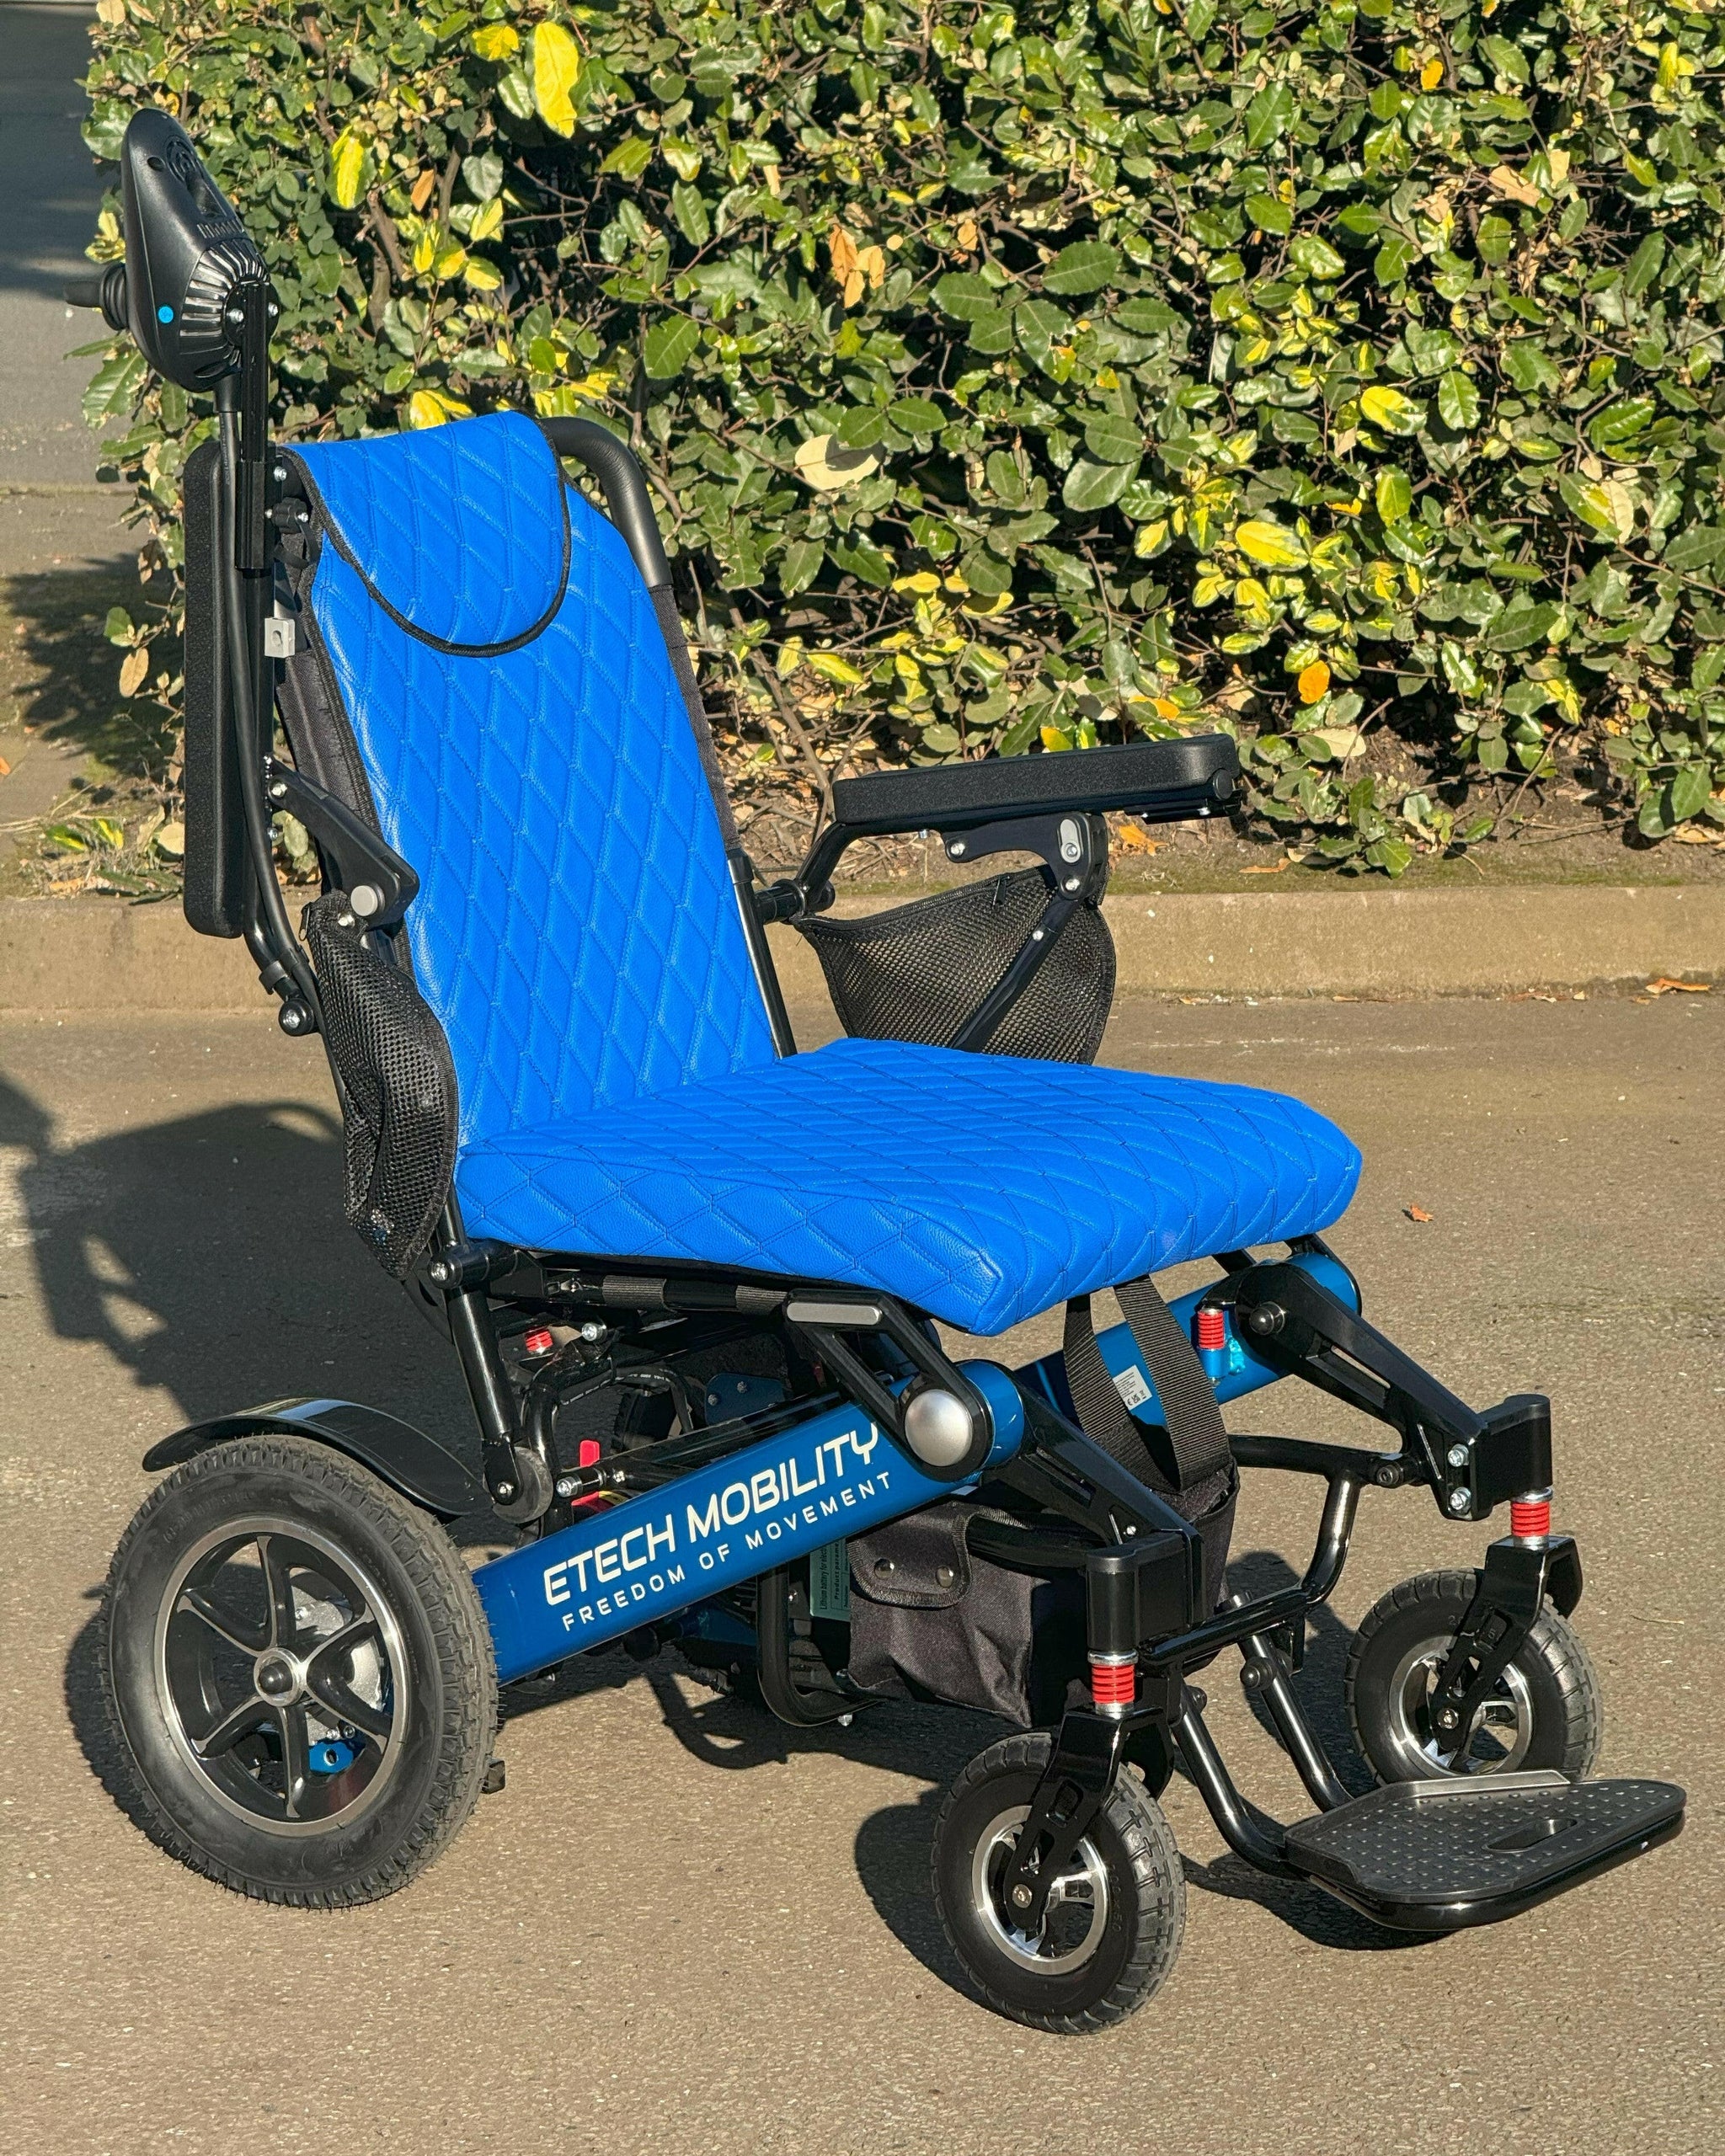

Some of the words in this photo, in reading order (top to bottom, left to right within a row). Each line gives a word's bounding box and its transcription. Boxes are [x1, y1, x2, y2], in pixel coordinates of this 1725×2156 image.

[543, 1513, 676, 1606] ETECH
[686, 1422, 879, 1544] MOBILITY
[562, 1565, 686, 1632] FREEDOM
[699, 1544, 730, 1570] OF
[745, 1471, 889, 1550] MOVEMENT
[820, 1562, 828, 1571] for
[820, 1571, 829, 1589] battery
[820, 1590, 828, 1610] Lithium
